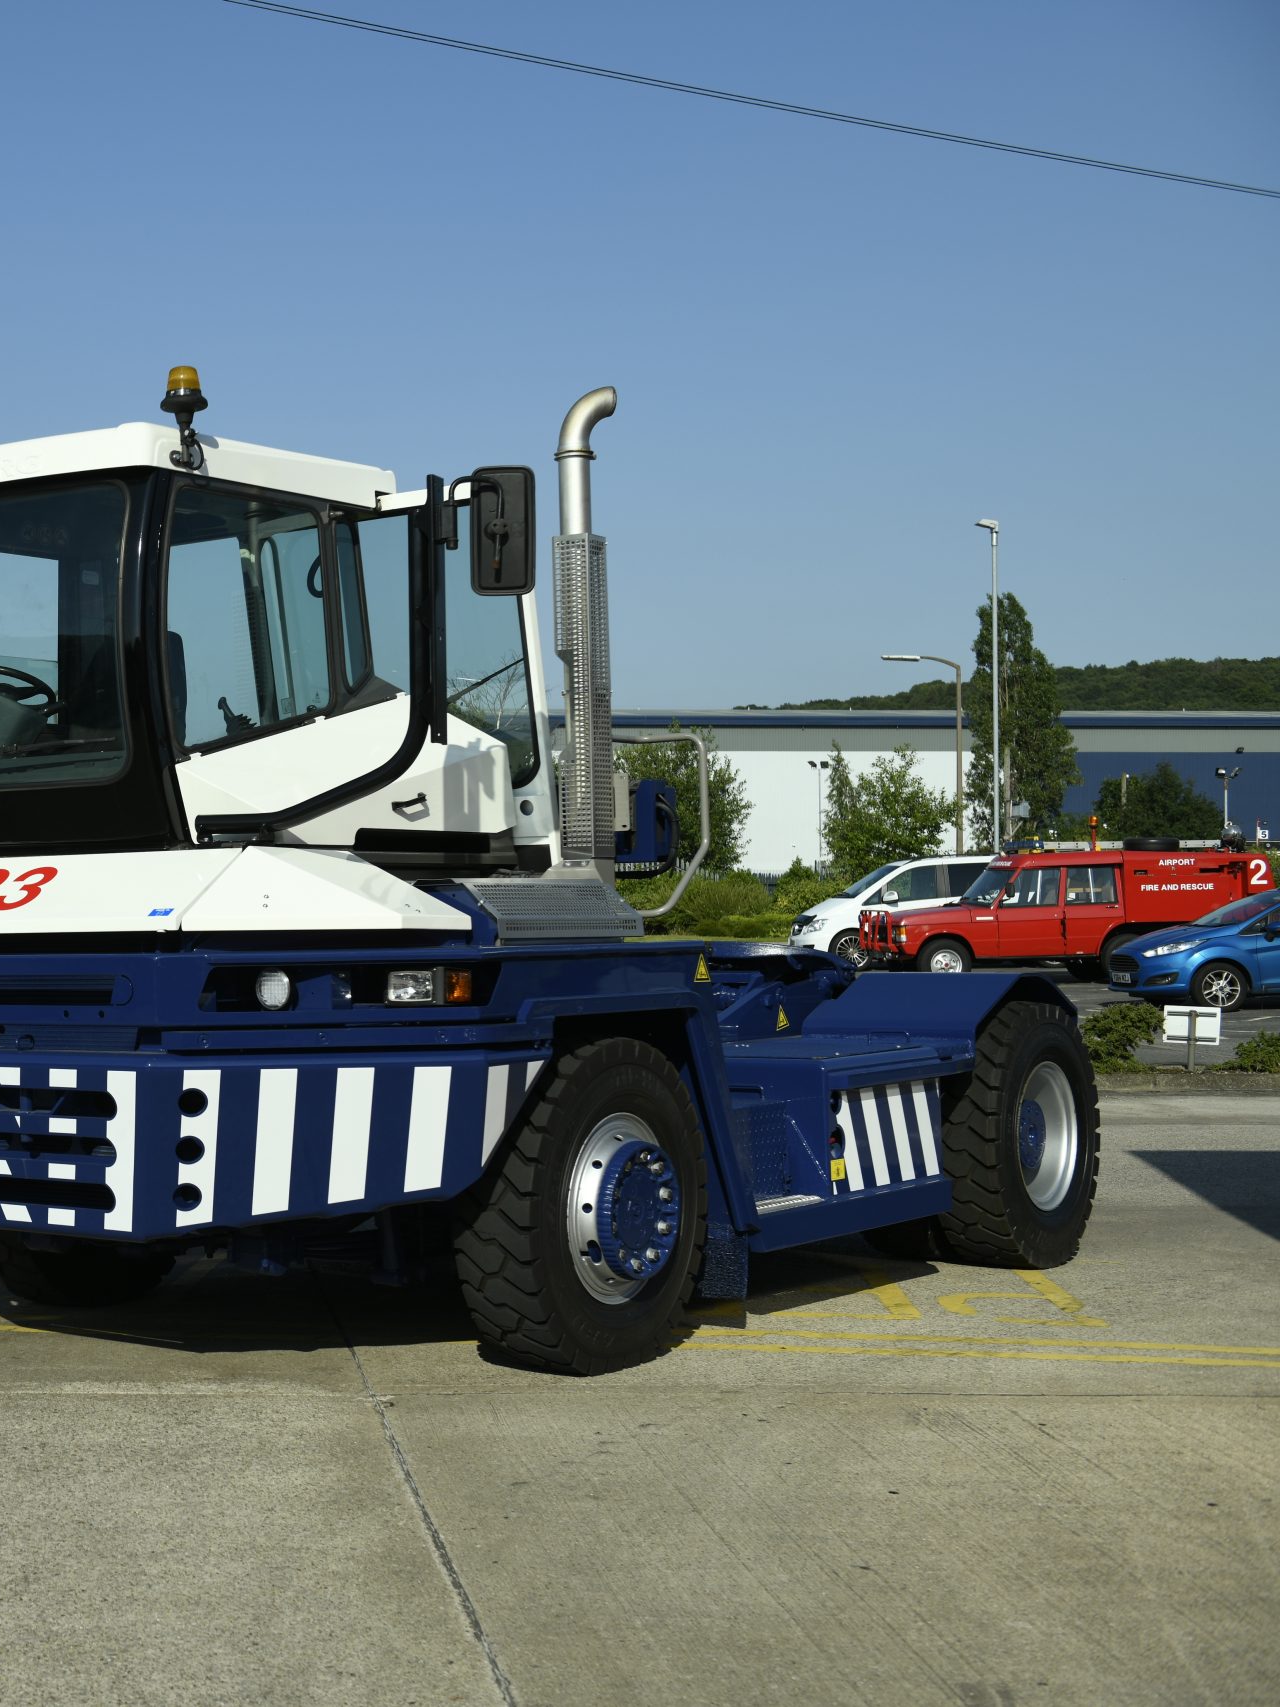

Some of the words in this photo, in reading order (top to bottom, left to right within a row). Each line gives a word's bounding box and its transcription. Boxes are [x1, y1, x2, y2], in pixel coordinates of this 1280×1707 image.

[1158, 858, 1195, 867] AIRPORT
[1249, 859, 1268, 885] 2
[1180, 883, 1214, 891] RESCUE
